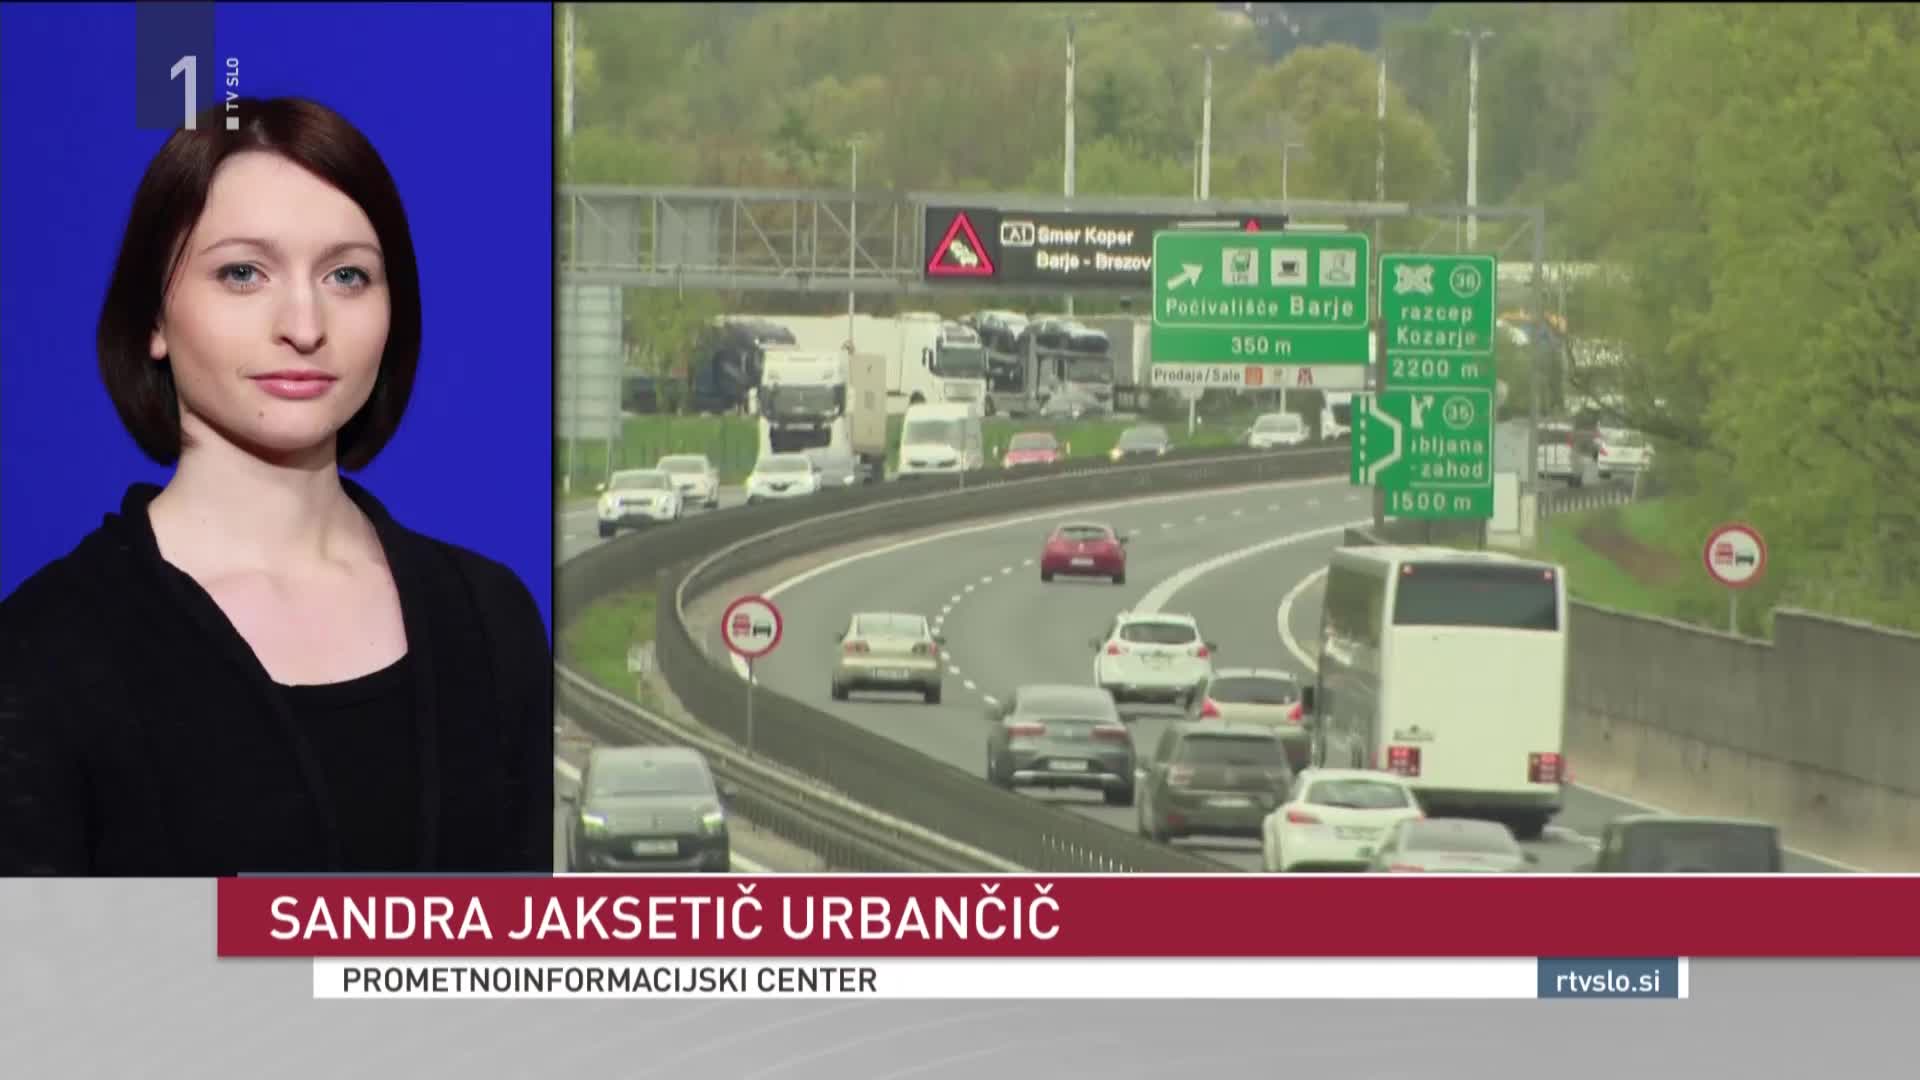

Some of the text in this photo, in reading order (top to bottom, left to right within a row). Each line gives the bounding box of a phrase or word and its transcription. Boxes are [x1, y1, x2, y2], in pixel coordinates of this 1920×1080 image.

[1037, 226, 1080, 244] Smer
[1085, 226, 1134, 248] Koper
[1037, 251, 1080, 271] Barje
[1165, 295, 1354, 321] Počivališče Barje
[1401, 306, 1473, 326] razcep
[1231, 336, 1292, 355] 350 m
[1396, 325, 1477, 349] Kozarje
[1392, 359, 1479, 379] 2200 m
[1392, 491, 1472, 511] 1500 m
